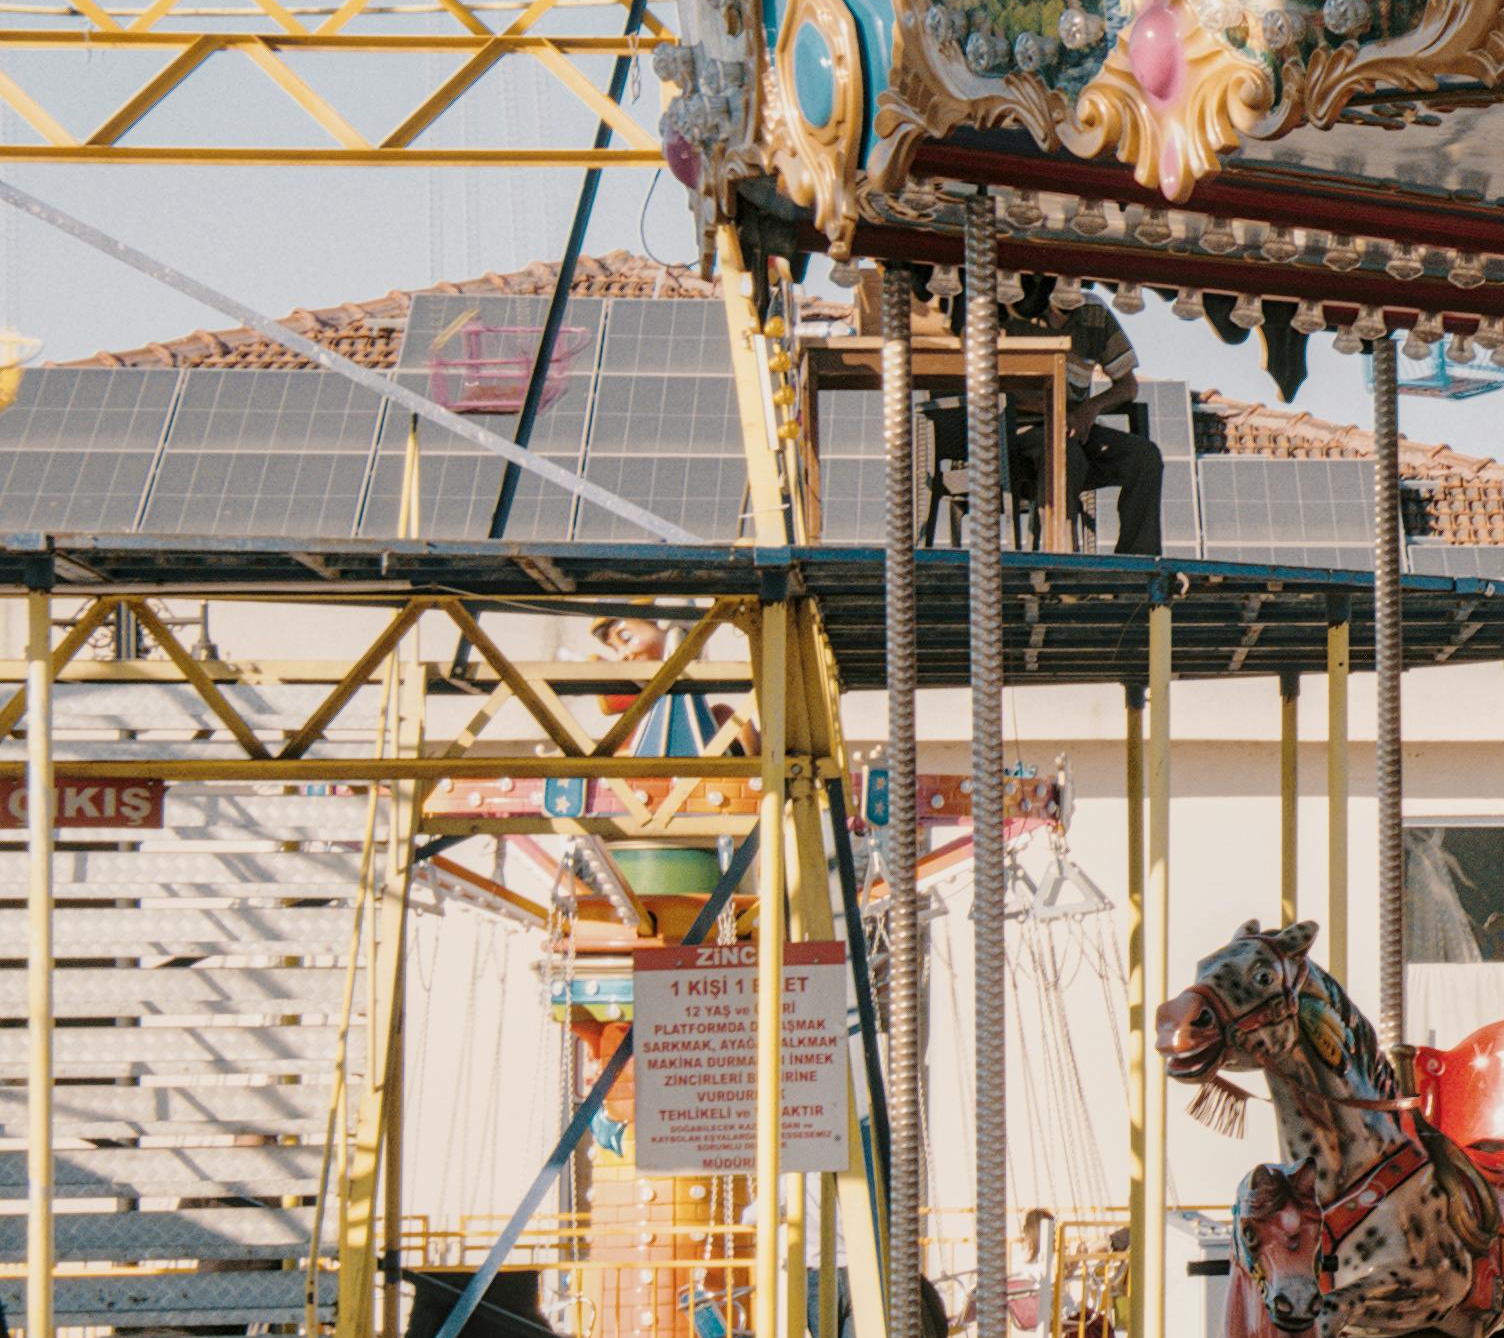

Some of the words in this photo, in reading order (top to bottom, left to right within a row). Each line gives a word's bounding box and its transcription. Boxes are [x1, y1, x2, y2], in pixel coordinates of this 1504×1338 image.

[671, 980, 679, 996] 1
[688, 975, 727, 999] KİŞİ
[736, 978, 744, 993] 1
[752, 976, 809, 994] BET
[720, 1036, 758, 1050] AYAĞ
[781, 1036, 837, 1047] ALKMAK
